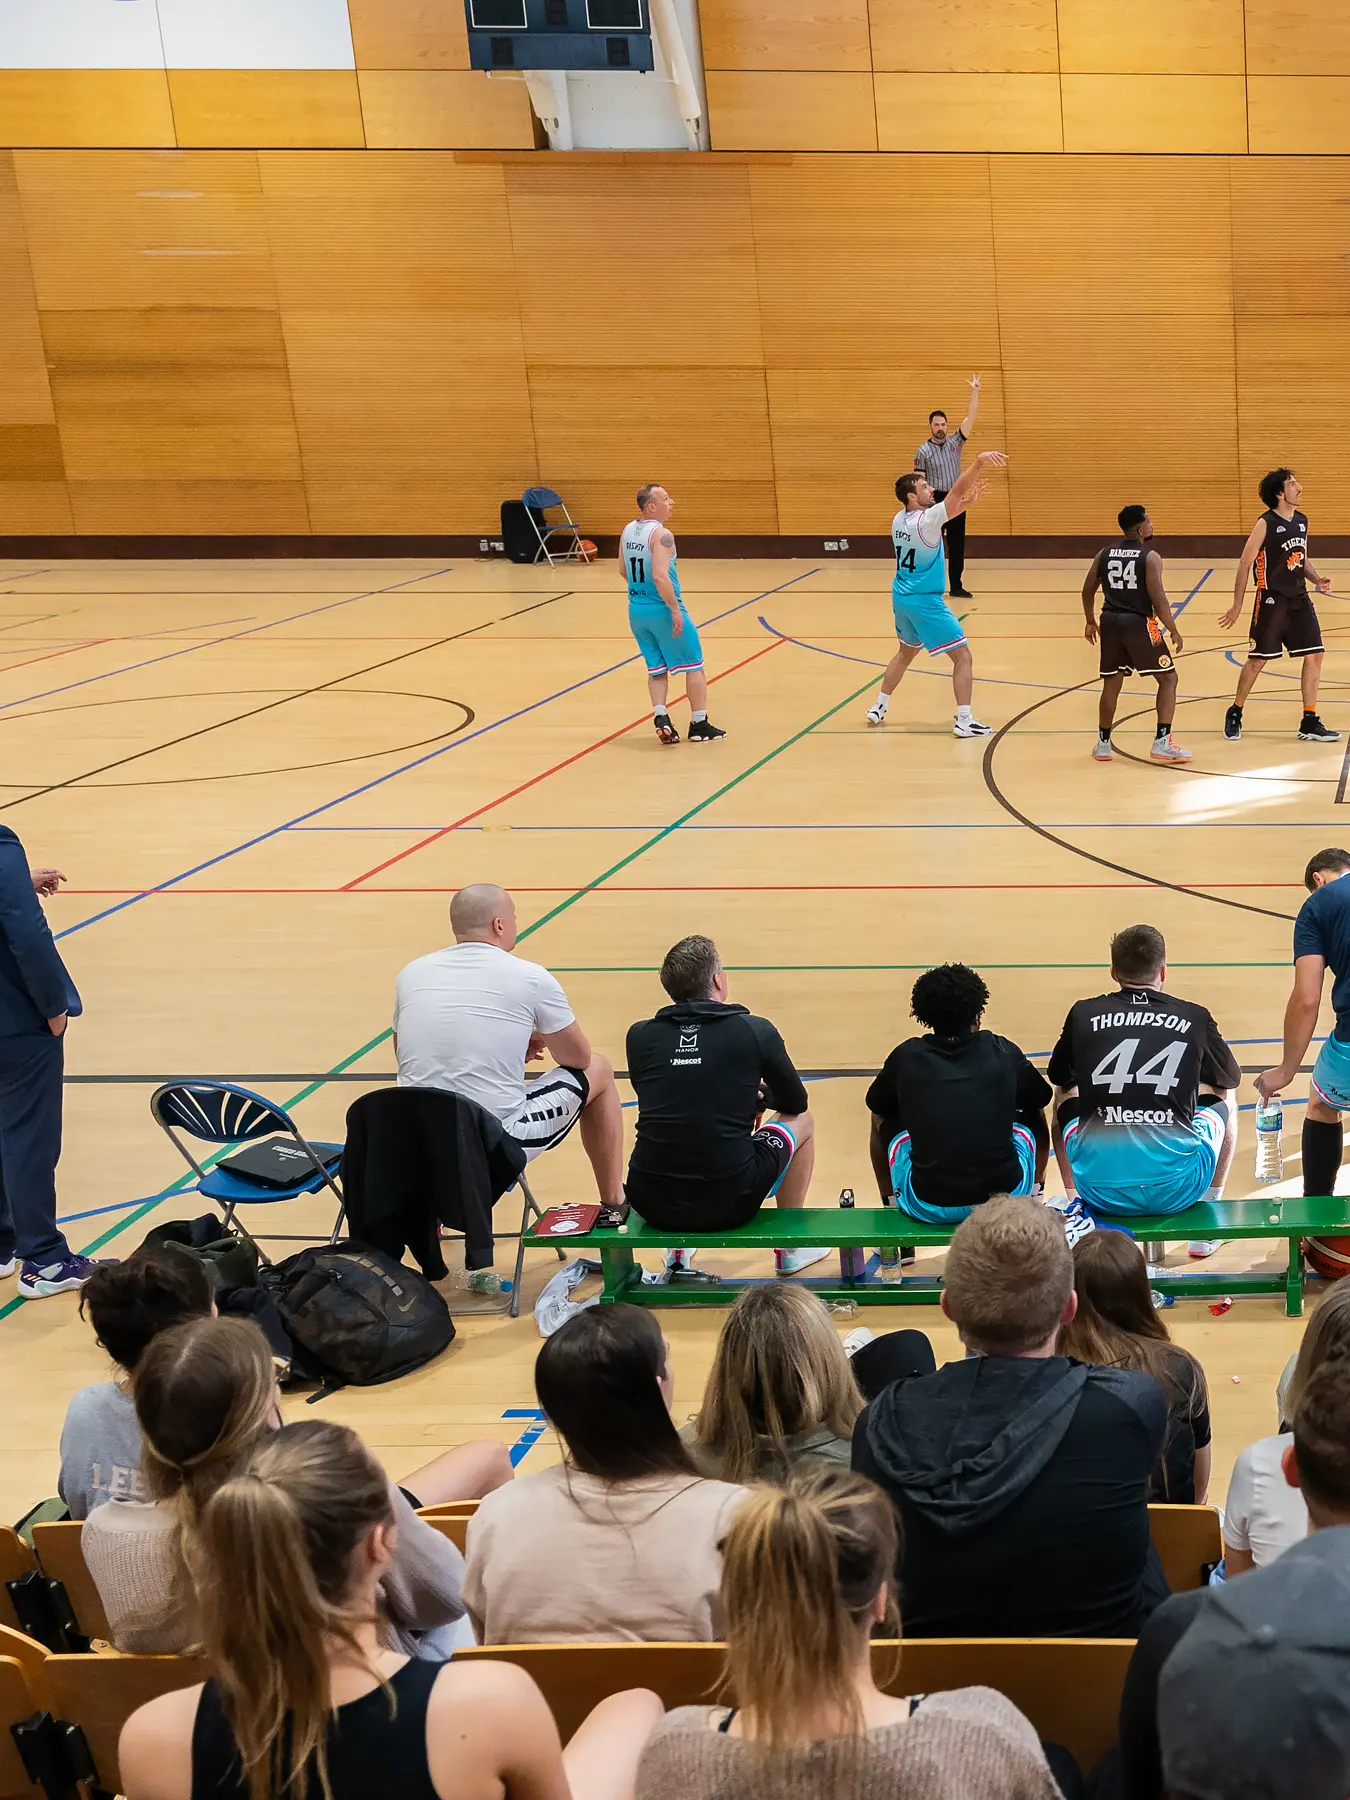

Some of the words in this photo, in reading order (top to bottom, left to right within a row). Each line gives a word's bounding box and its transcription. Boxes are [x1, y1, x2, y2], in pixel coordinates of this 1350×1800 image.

[630, 557, 645, 583] 11
[895, 546, 916, 573] 14
[1107, 560, 1138, 589] 24
[1090, 1012, 1191, 1034] THOMPSON
[672, 1057, 702, 1066] Nescot
[1091, 1038, 1188, 1095] 44
[1105, 1106, 1174, 1123] Nescot
